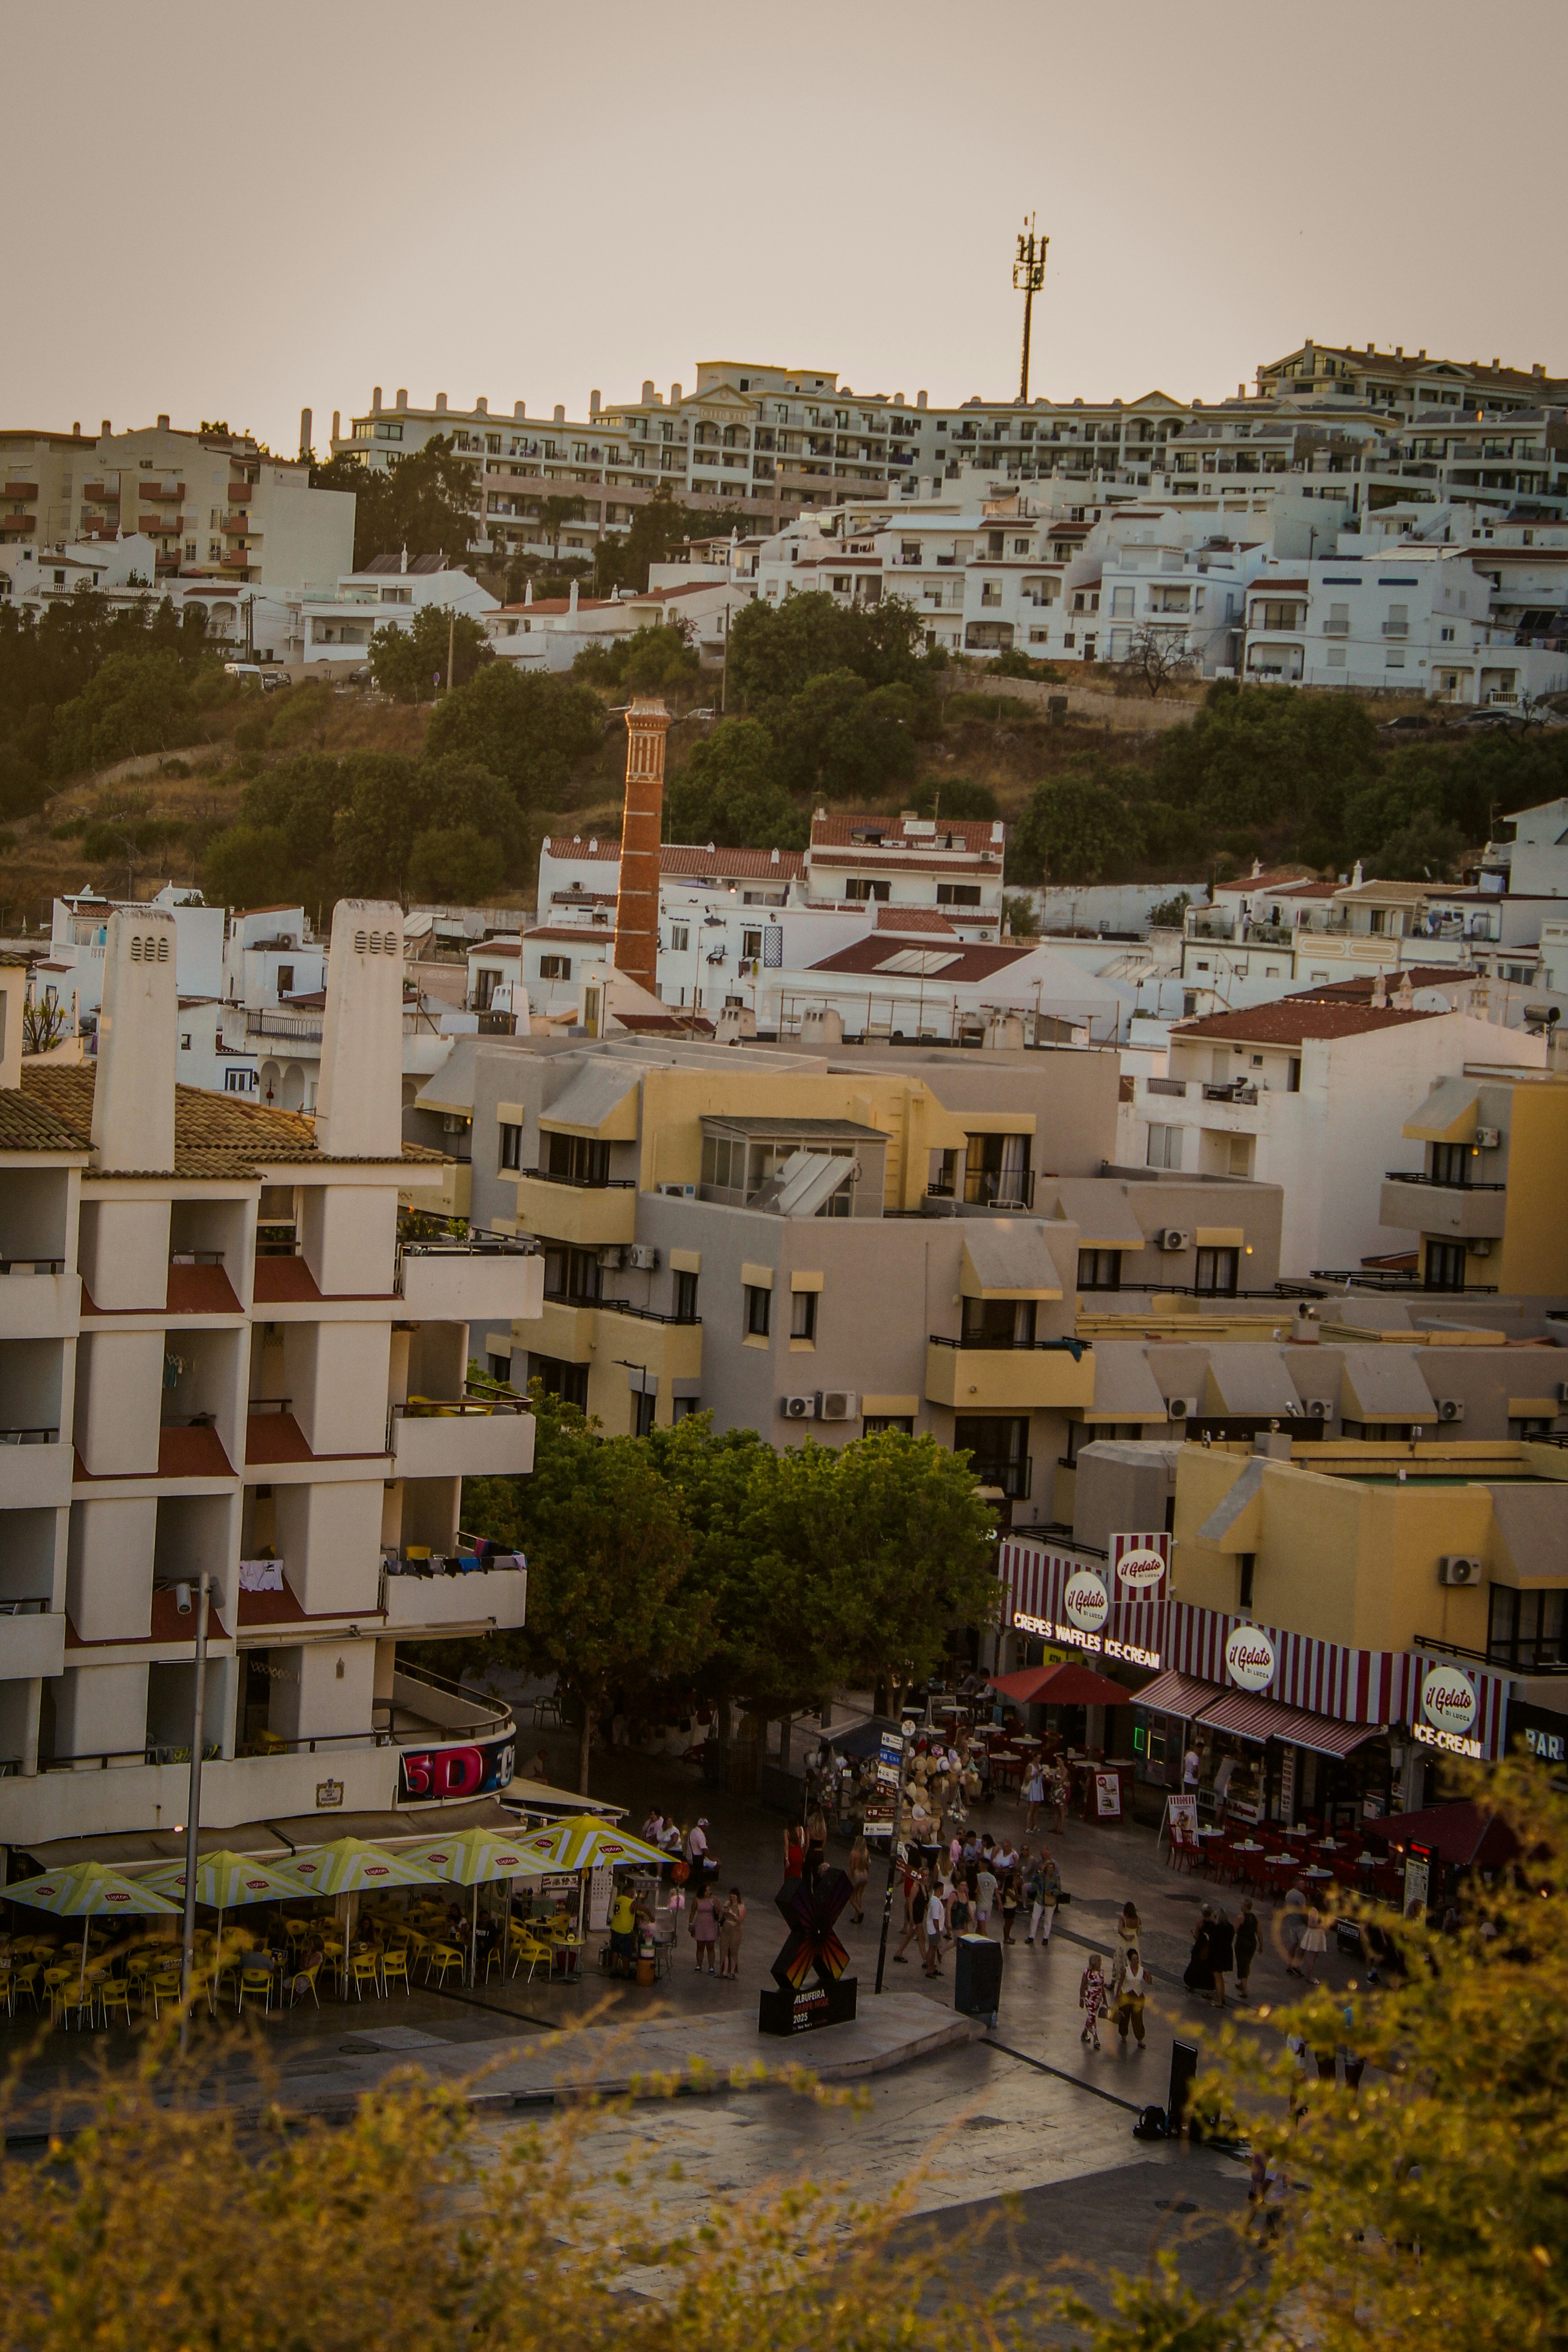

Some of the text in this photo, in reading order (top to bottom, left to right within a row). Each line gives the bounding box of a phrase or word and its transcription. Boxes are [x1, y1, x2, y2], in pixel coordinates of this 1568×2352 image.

[1121, 1559, 1161, 1578] il Gelato
[1068, 1590, 1105, 1615] il Gelato
[1013, 1612, 1160, 1670] CREPES WAFFLES ICE-CREAM
[1049, 1654, 1061, 1663] ATM
[1230, 1646, 1271, 1672] il Gelato
[1254, 1671, 1269, 1679] LUCCA
[1426, 1687, 1472, 1715] il Gelato
[1453, 1712, 1470, 1722] LUCCA
[1414, 1724, 1482, 1759] ICE-CREAM
[794, 1989, 825, 2005] ALBUFEIRA
[793, 2012, 808, 2024] 2025
